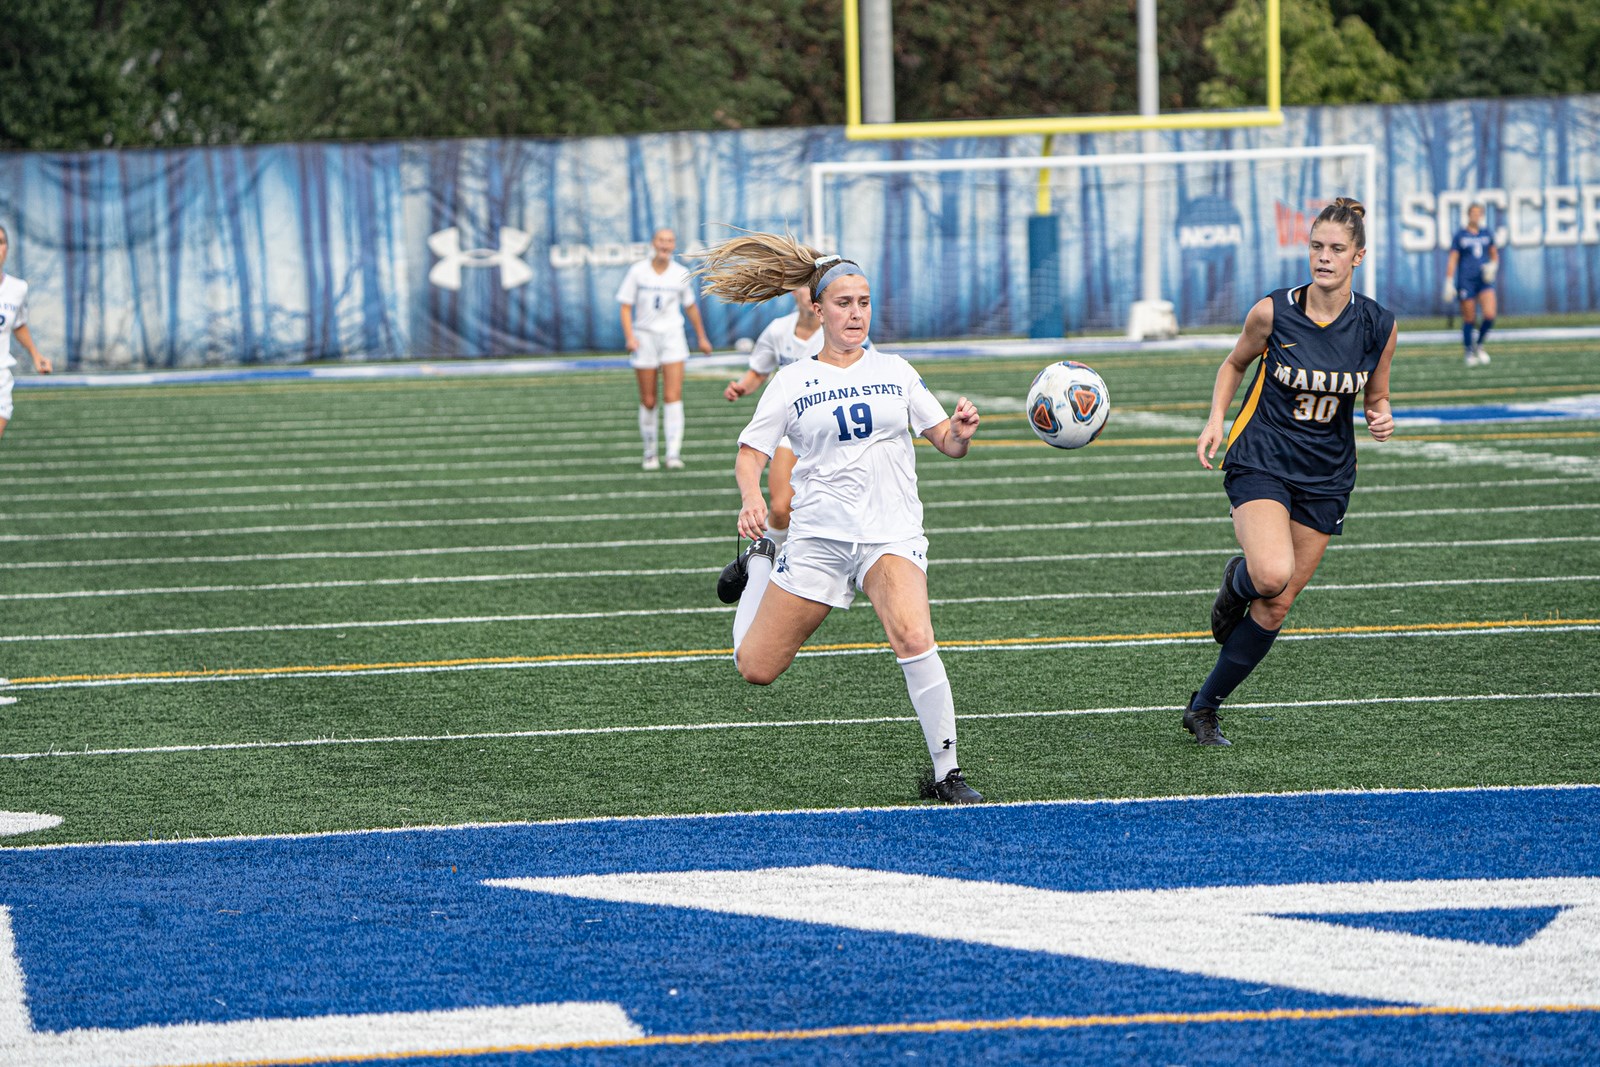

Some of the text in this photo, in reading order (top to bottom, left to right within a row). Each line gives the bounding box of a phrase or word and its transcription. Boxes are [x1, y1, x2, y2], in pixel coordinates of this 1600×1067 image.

[551, 243, 656, 268] UNDE
[1273, 361, 1369, 394] MARIAN
[793, 383, 903, 419] INDIANA STATE
[1293, 392, 1340, 423] 30
[832, 402, 873, 442] 19
